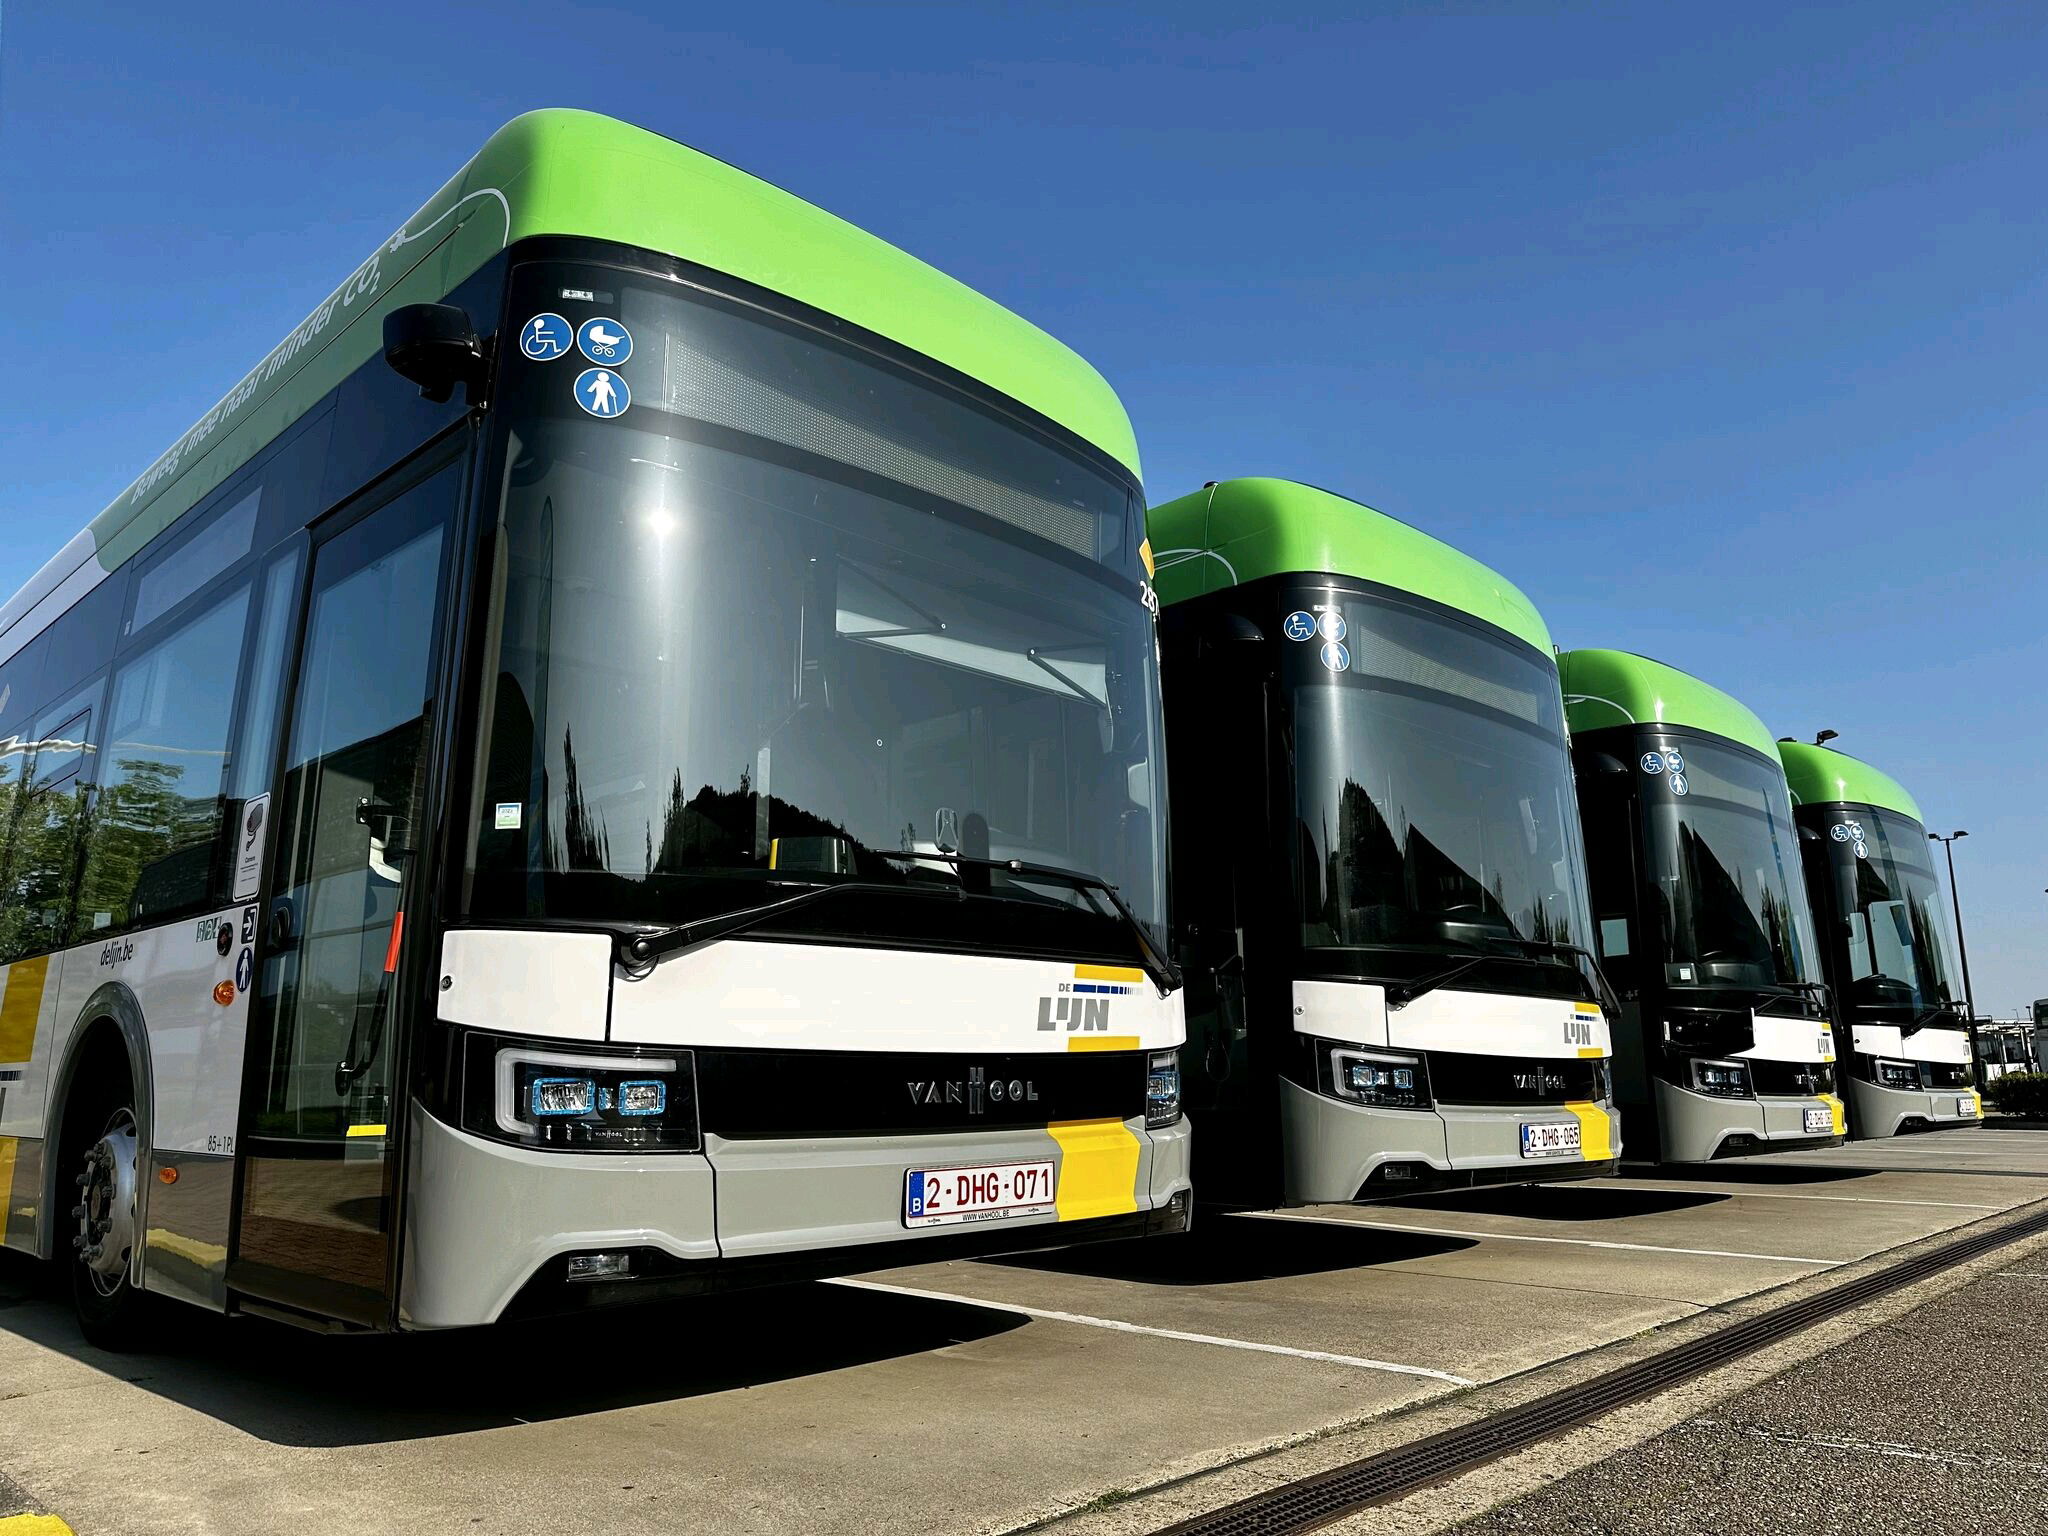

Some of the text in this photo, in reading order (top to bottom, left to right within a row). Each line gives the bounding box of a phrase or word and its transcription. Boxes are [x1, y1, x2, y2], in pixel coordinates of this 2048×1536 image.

[185, 411, 221, 456] mee
[220, 366, 266, 424] naar
[265, 296, 340, 381] minder
[100, 937, 133, 970] delijn.be
[1058, 983, 1071, 993] DE
[1037, 997, 1110, 1031] LIJN
[1563, 1022, 1591, 1045] LIJN
[912, 1197, 921, 1212] B
